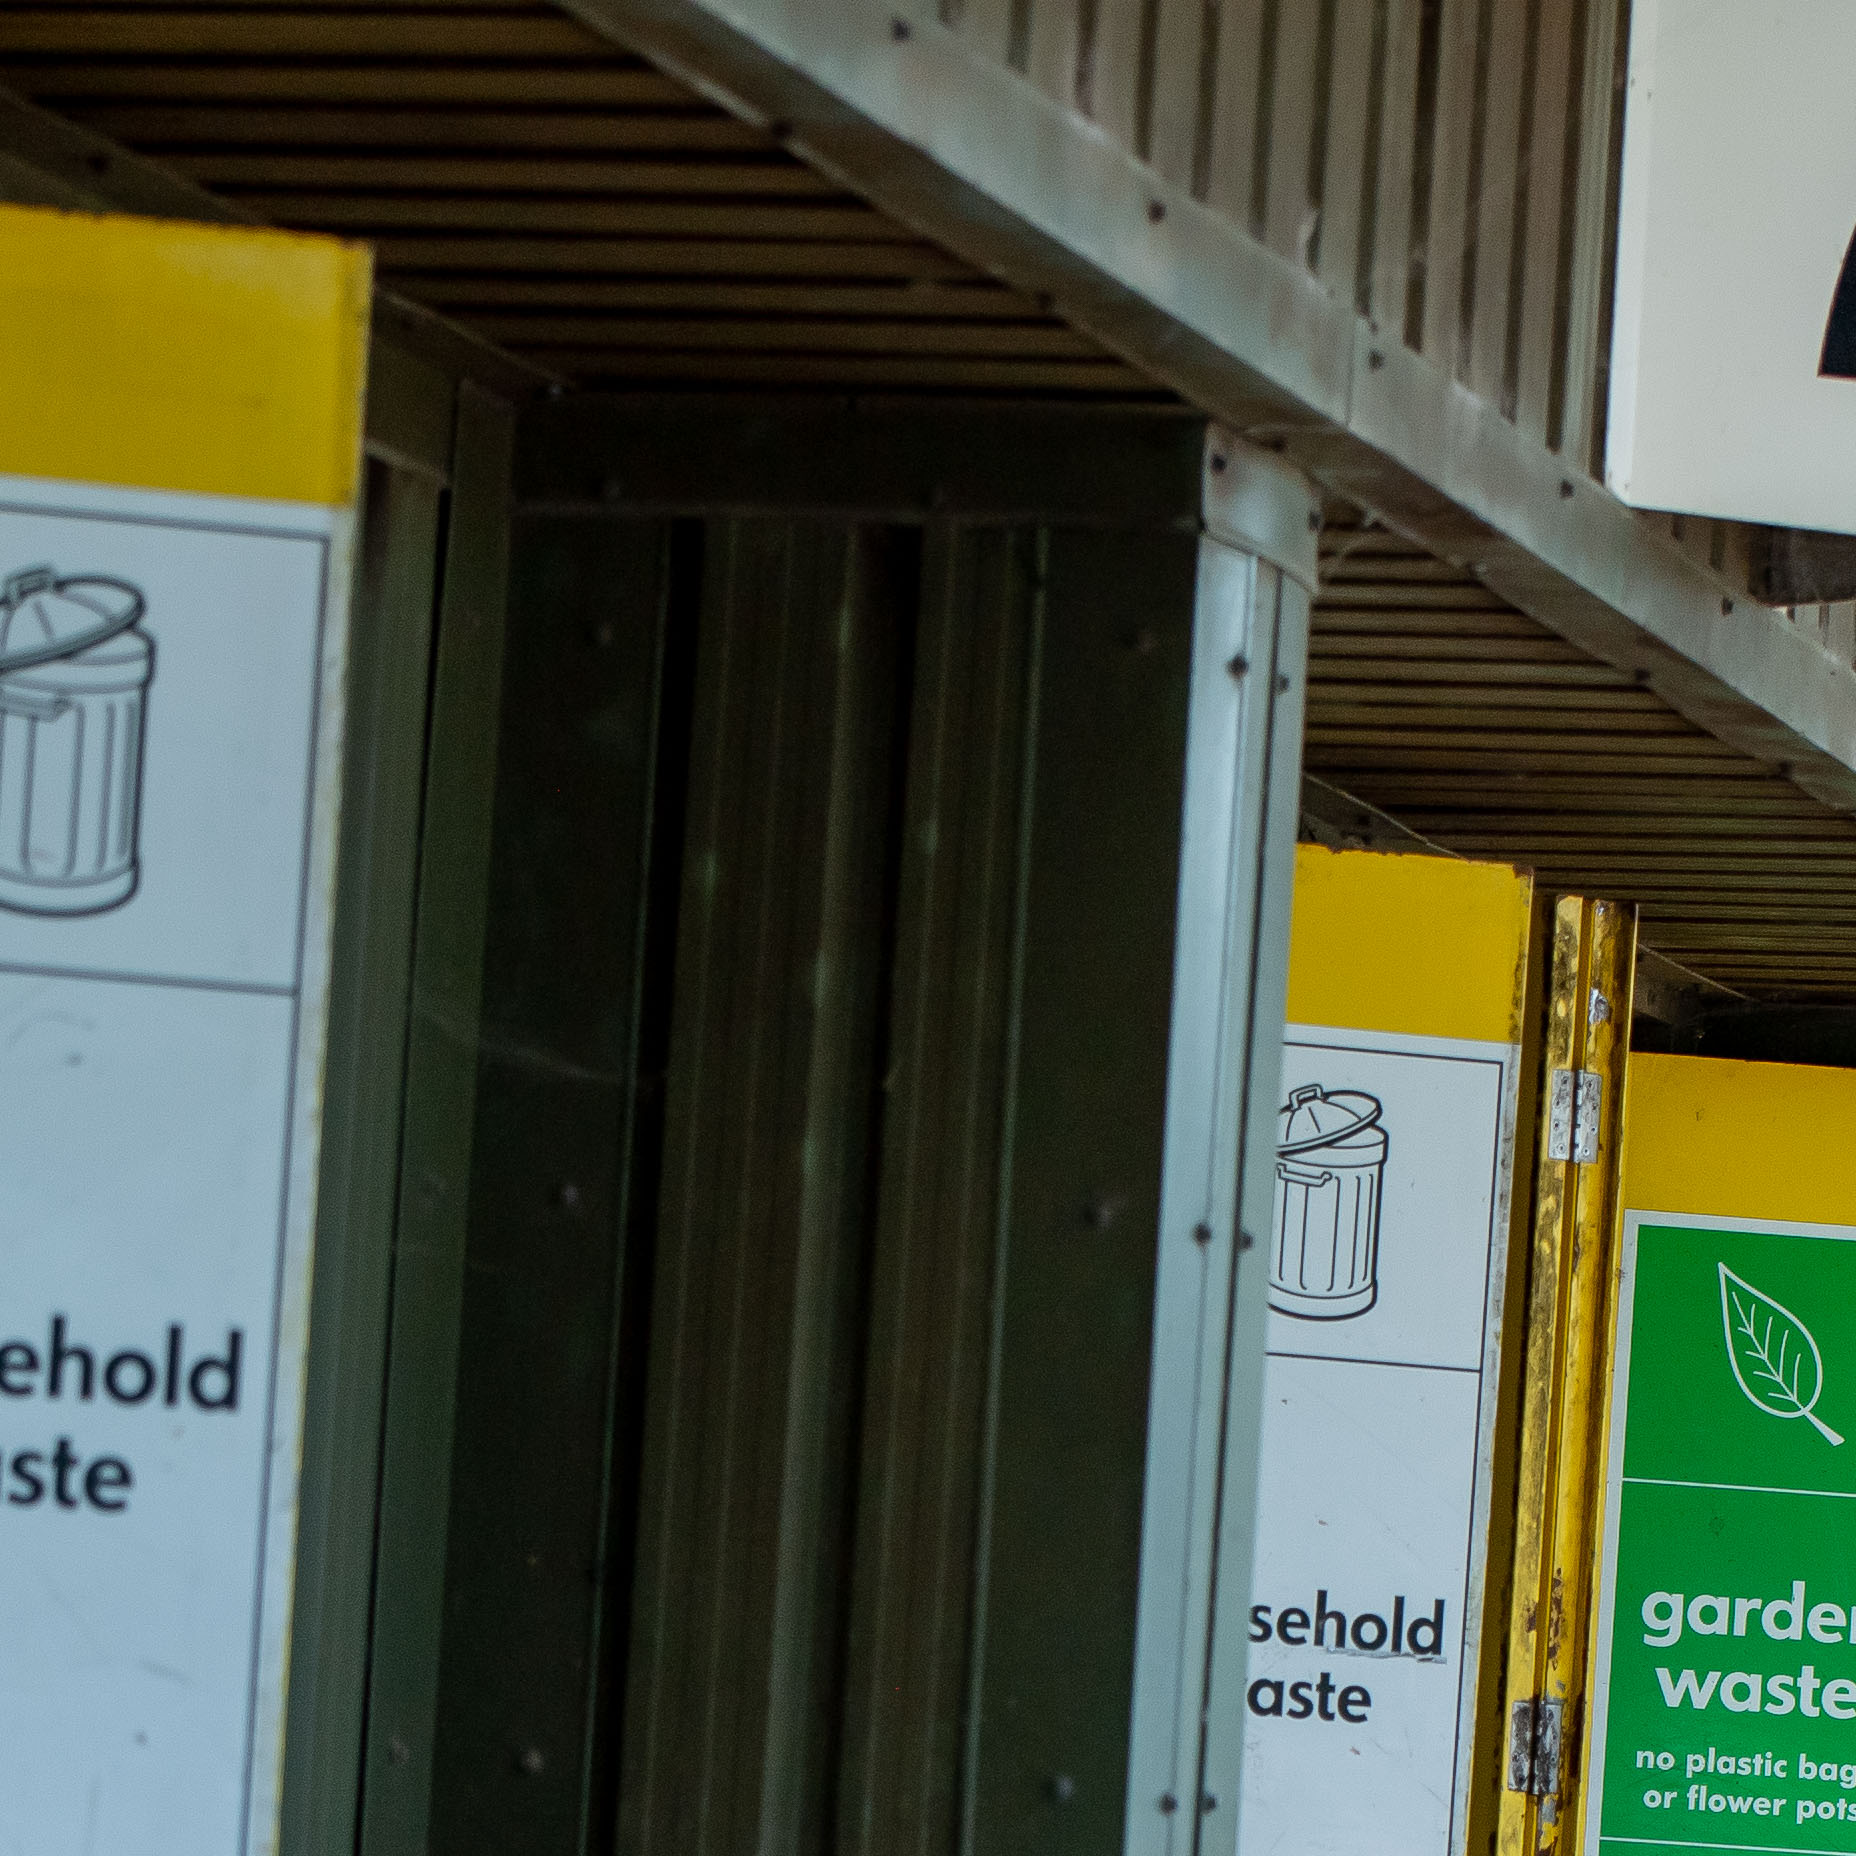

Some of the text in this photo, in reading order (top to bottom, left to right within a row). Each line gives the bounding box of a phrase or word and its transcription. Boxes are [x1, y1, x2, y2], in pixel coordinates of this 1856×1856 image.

[1247, 1588, 1446, 1656] sehold
[1246, 1671, 1372, 1724] aste
[1635, 1749, 1676, 1771] no
[1685, 1746, 1789, 1779] plastic
[1642, 1788, 1678, 1809] or
[1686, 1784, 1788, 1817] flower
